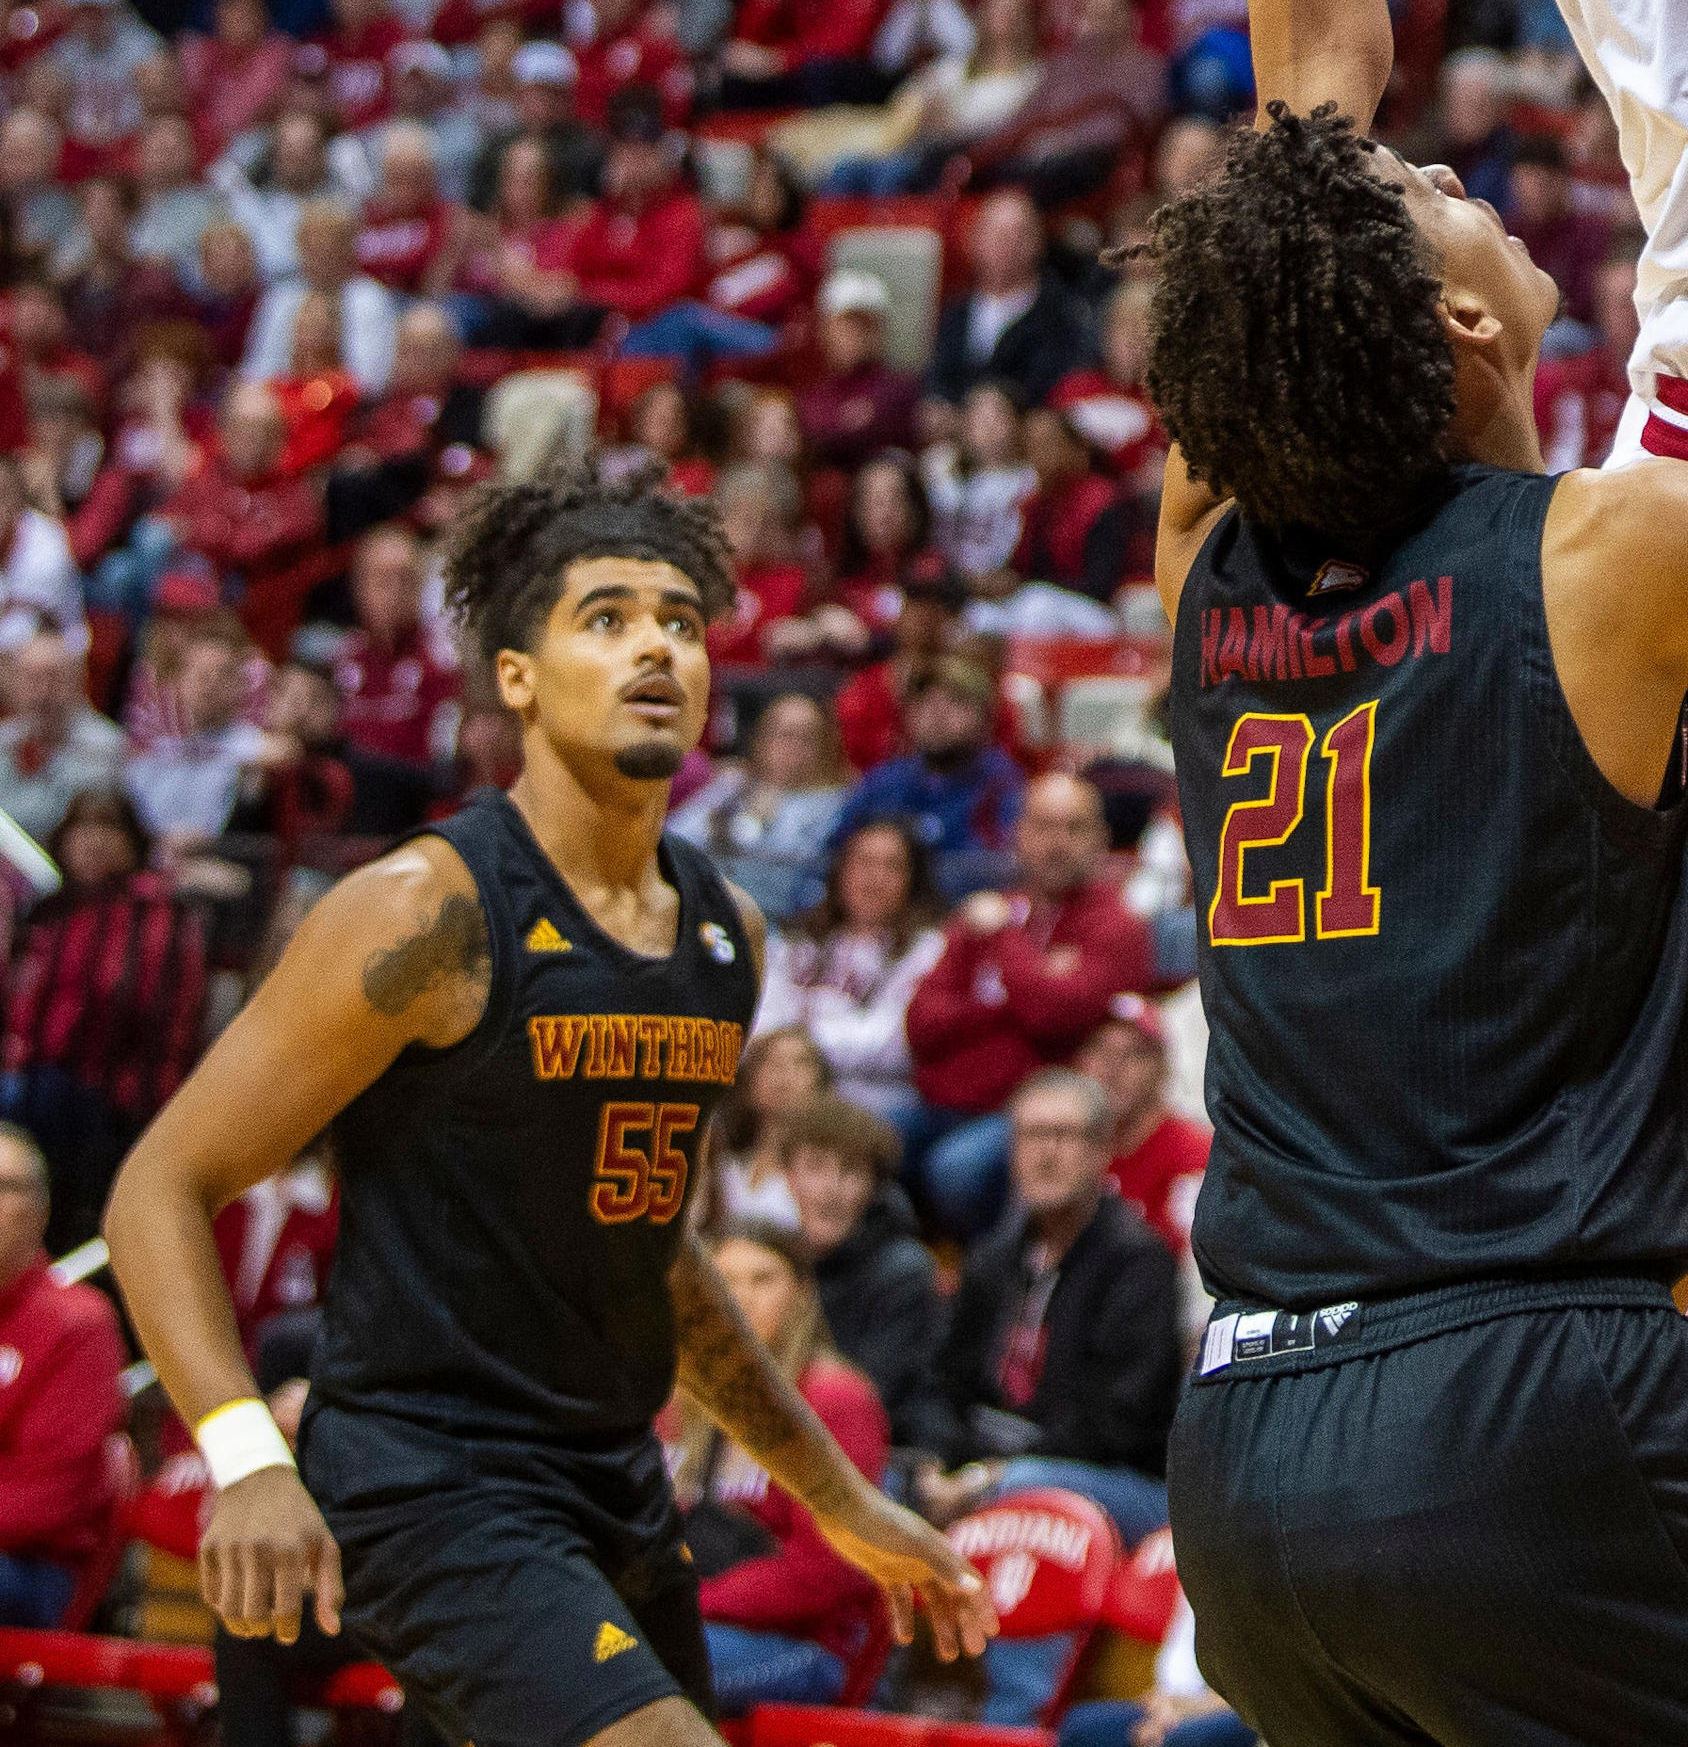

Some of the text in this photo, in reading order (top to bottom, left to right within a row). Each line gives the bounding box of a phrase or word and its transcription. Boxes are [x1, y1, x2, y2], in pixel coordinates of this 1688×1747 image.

[1200, 576, 1453, 688] HAMILTON
[1208, 698, 1382, 948] 21
[528, 1014, 744, 1085] WINTHRO
[589, 1101, 701, 1224] 55
